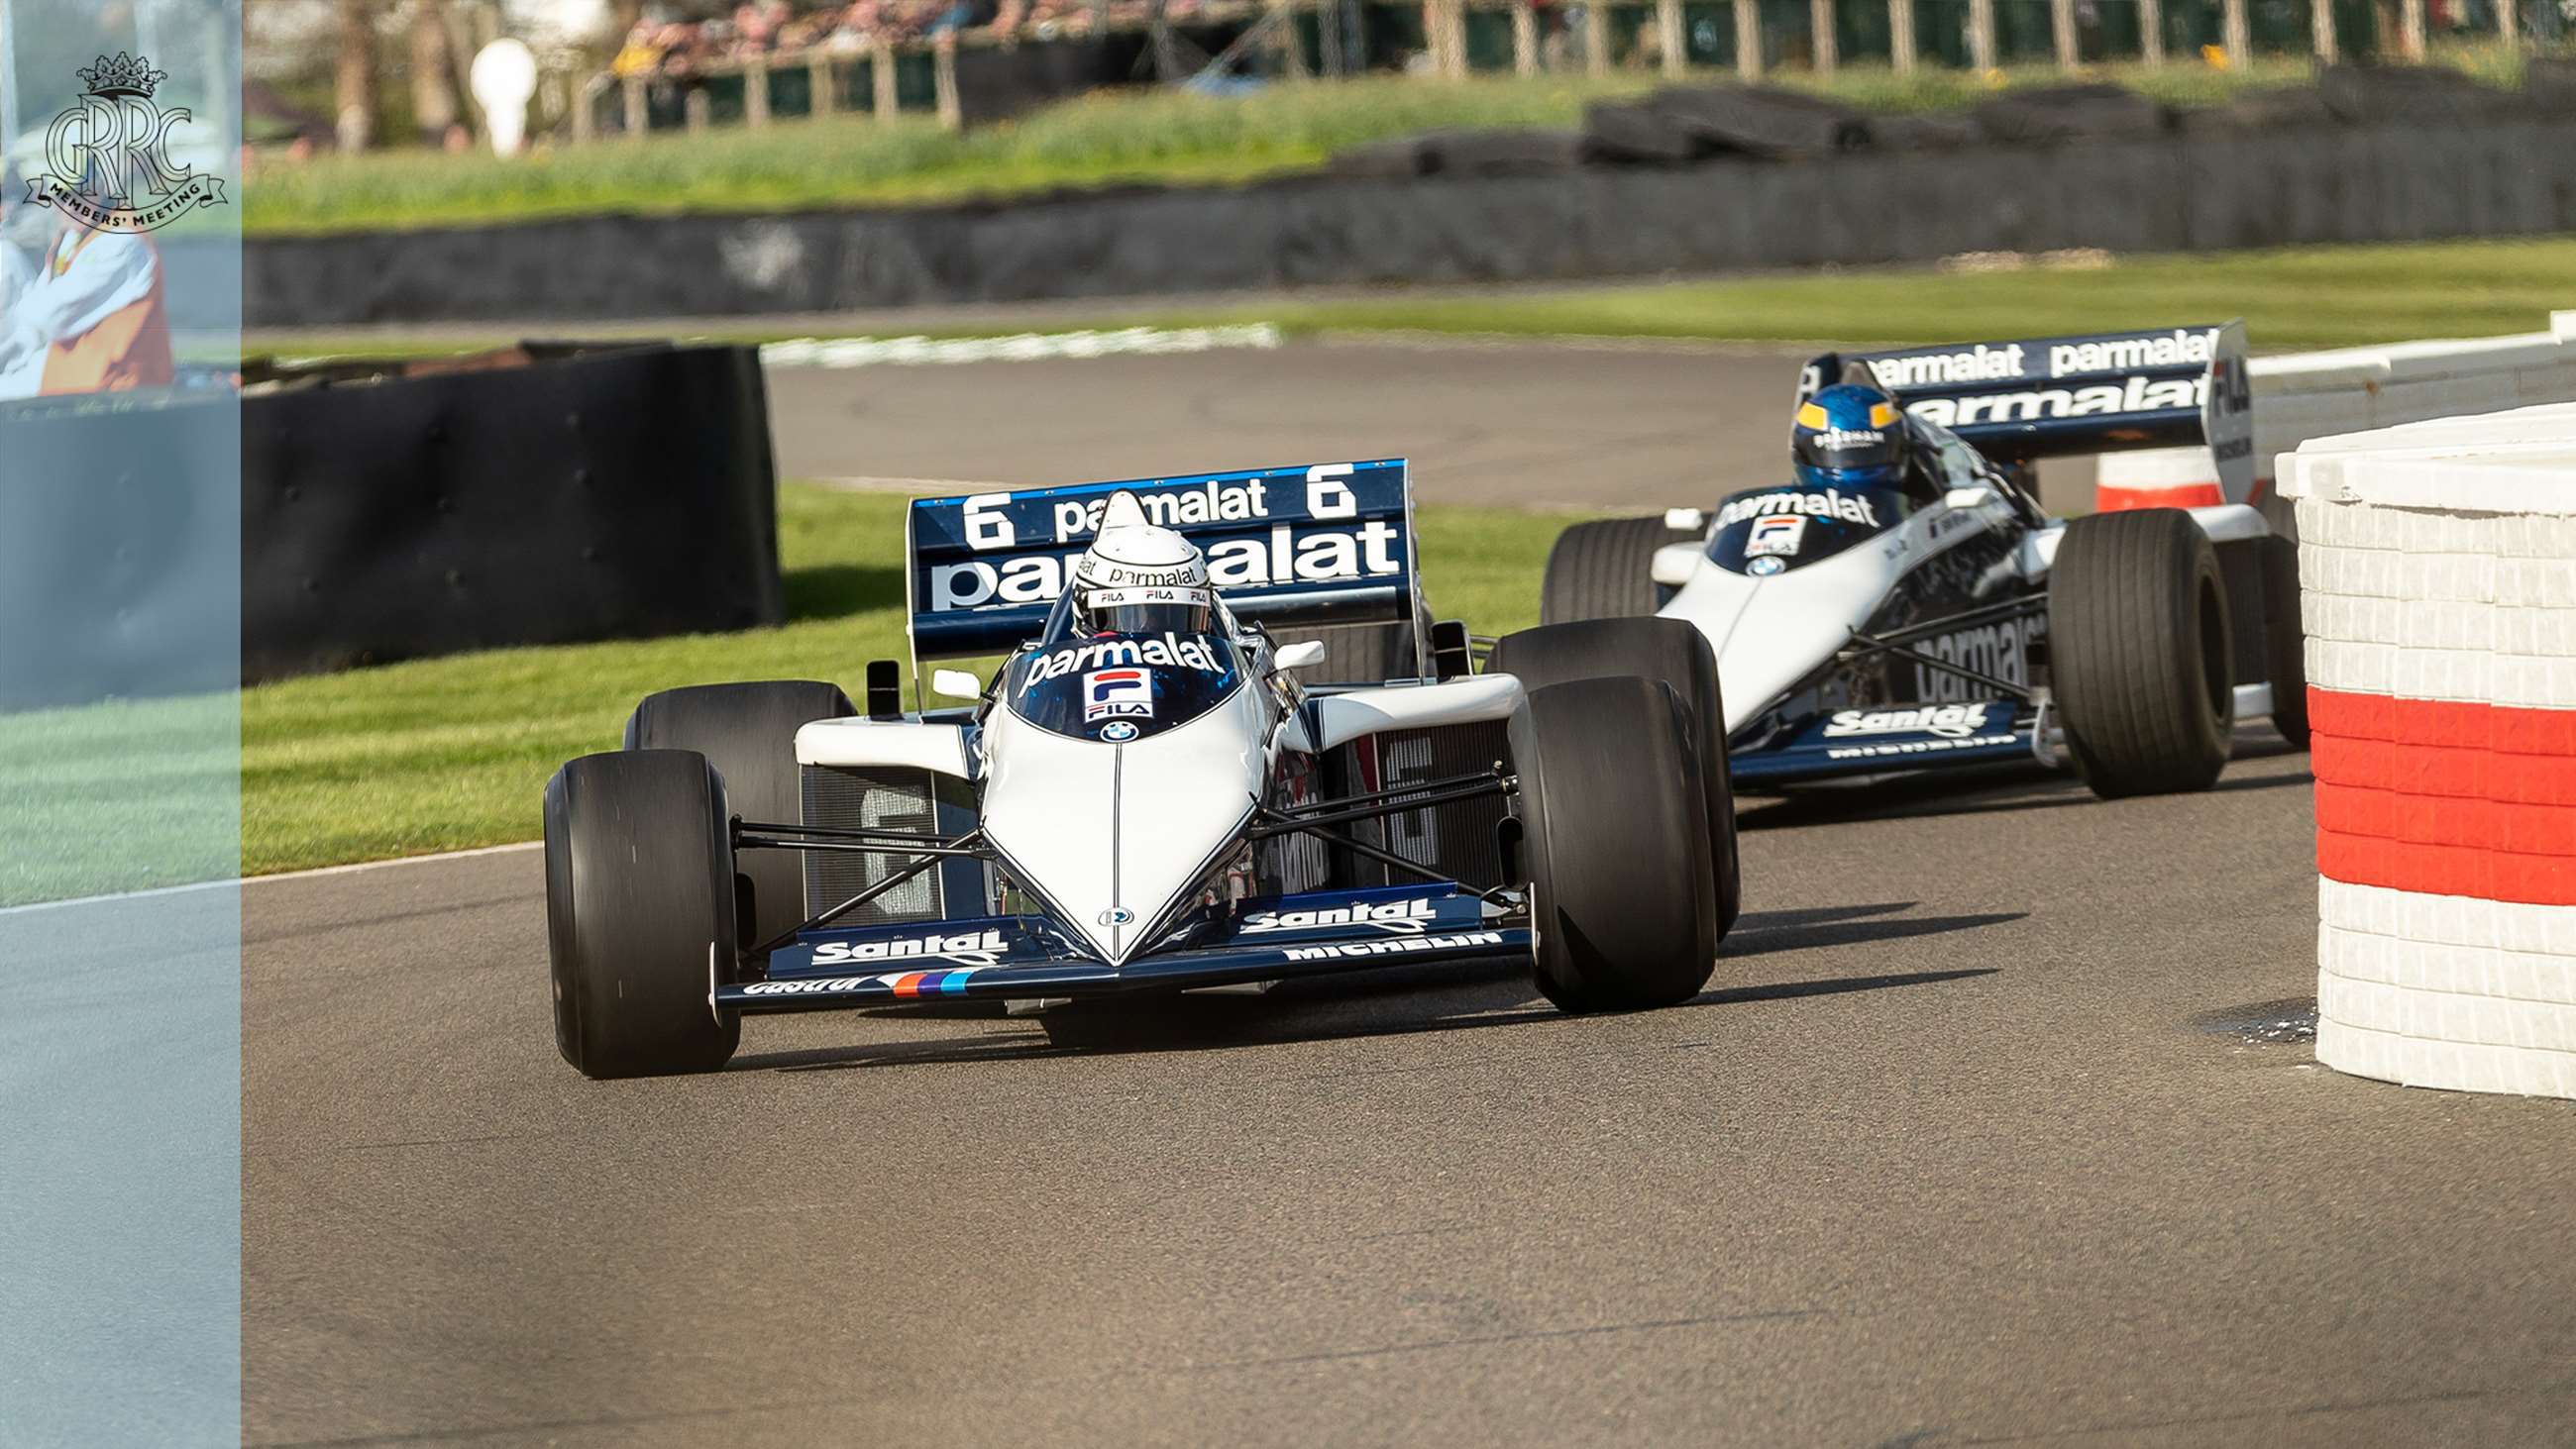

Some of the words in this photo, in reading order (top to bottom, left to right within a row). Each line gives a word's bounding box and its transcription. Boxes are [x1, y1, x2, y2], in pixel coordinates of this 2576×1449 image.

[1906, 372, 2213, 427] armalat
[963, 492, 1016, 551] 6
[1307, 463, 1357, 519] 6
[1715, 488, 1881, 531] parmalat
[1109, 567, 1198, 587] parmalat
[1101, 592, 1125, 603] FILA
[1146, 589, 1174, 600] FILA
[1018, 632, 1226, 698] parmalat
[1088, 703, 1150, 719] FILA
[1283, 932, 1503, 961] MICHELIN
